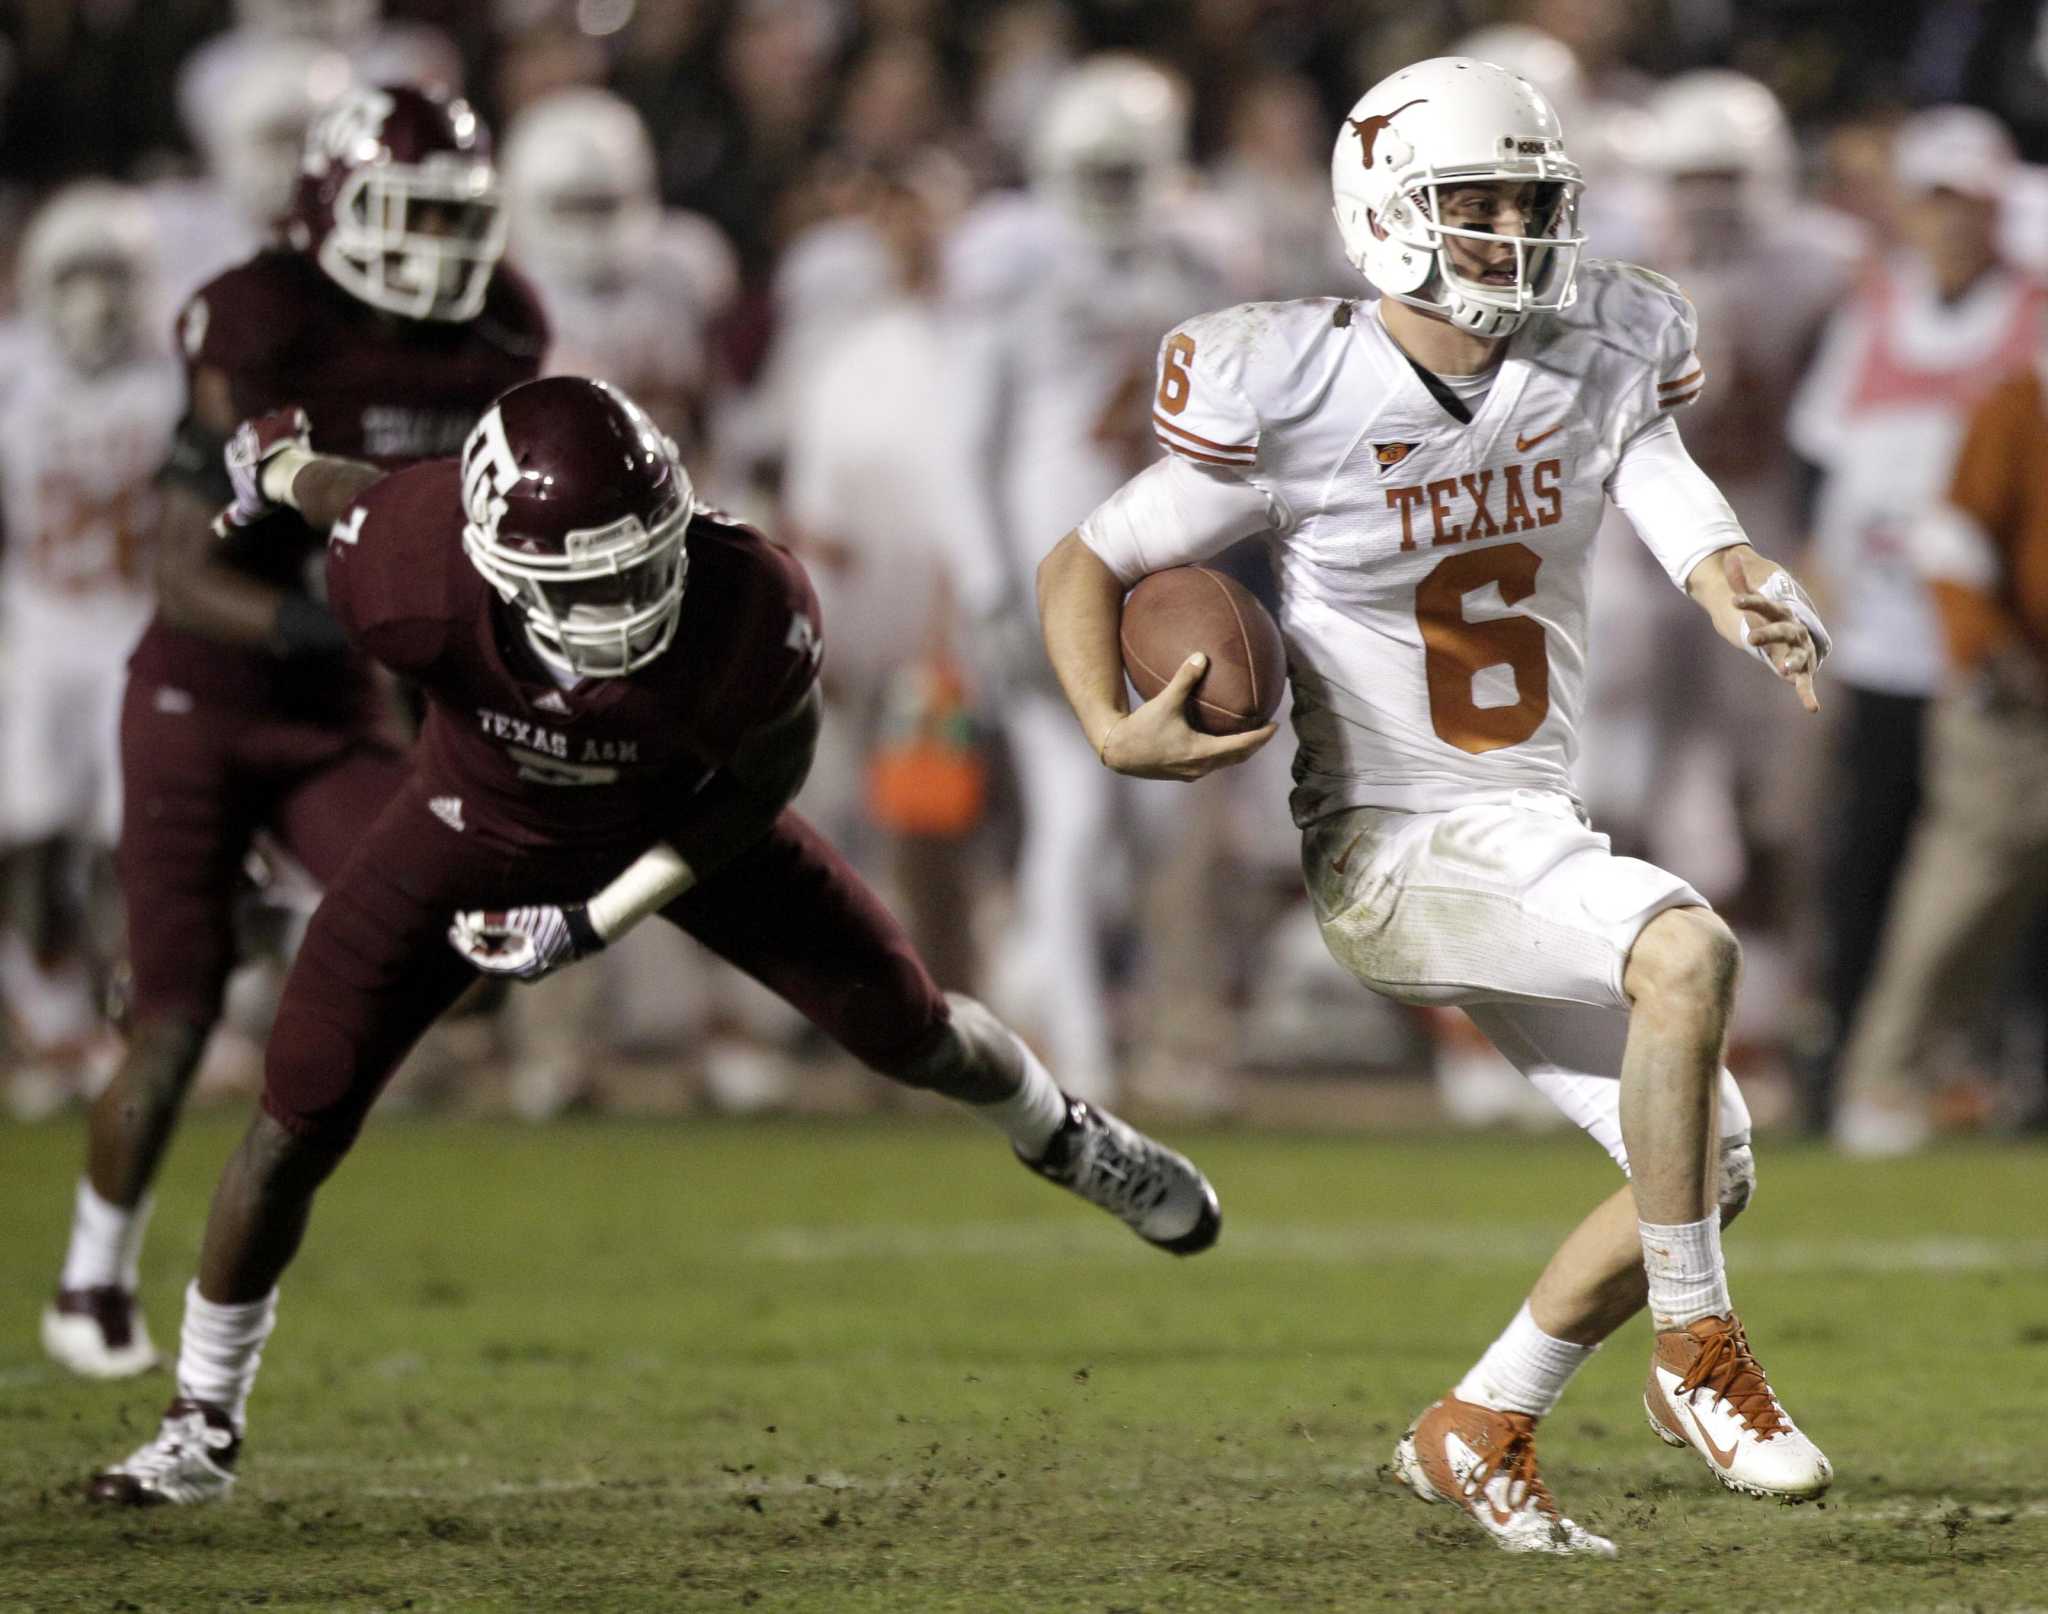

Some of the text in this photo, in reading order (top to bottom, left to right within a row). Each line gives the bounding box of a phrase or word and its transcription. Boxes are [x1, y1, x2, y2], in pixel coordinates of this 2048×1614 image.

[1158, 332, 1196, 416] 6
[1387, 459, 1562, 550] TEXAS
[1415, 542, 1549, 755] 6
[477, 709, 638, 762] TEXAS A&M
